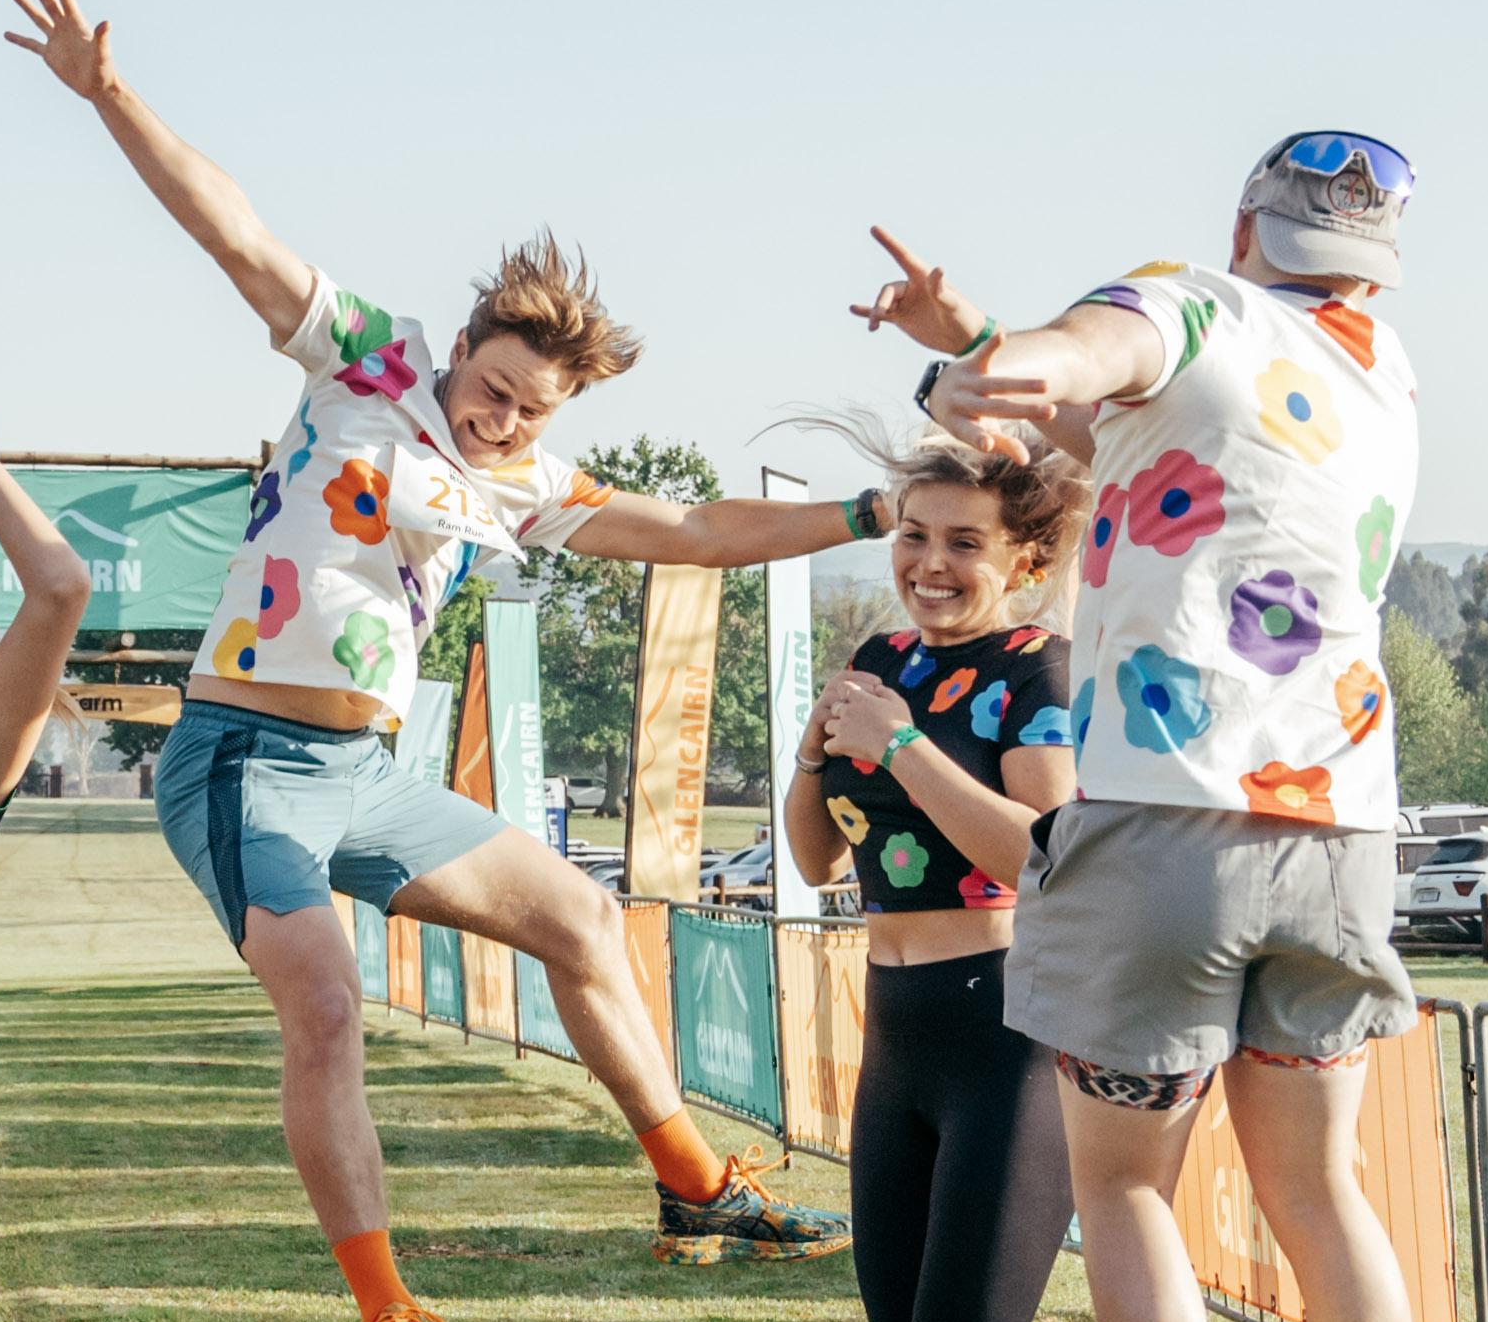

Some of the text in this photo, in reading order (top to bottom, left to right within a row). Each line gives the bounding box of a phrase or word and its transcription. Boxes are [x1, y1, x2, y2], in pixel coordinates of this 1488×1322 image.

[438, 519, 485, 539] Ram Run
[520, 702, 545, 842] LENCAIRN
[674, 665, 709, 856] GLENCAIRN
